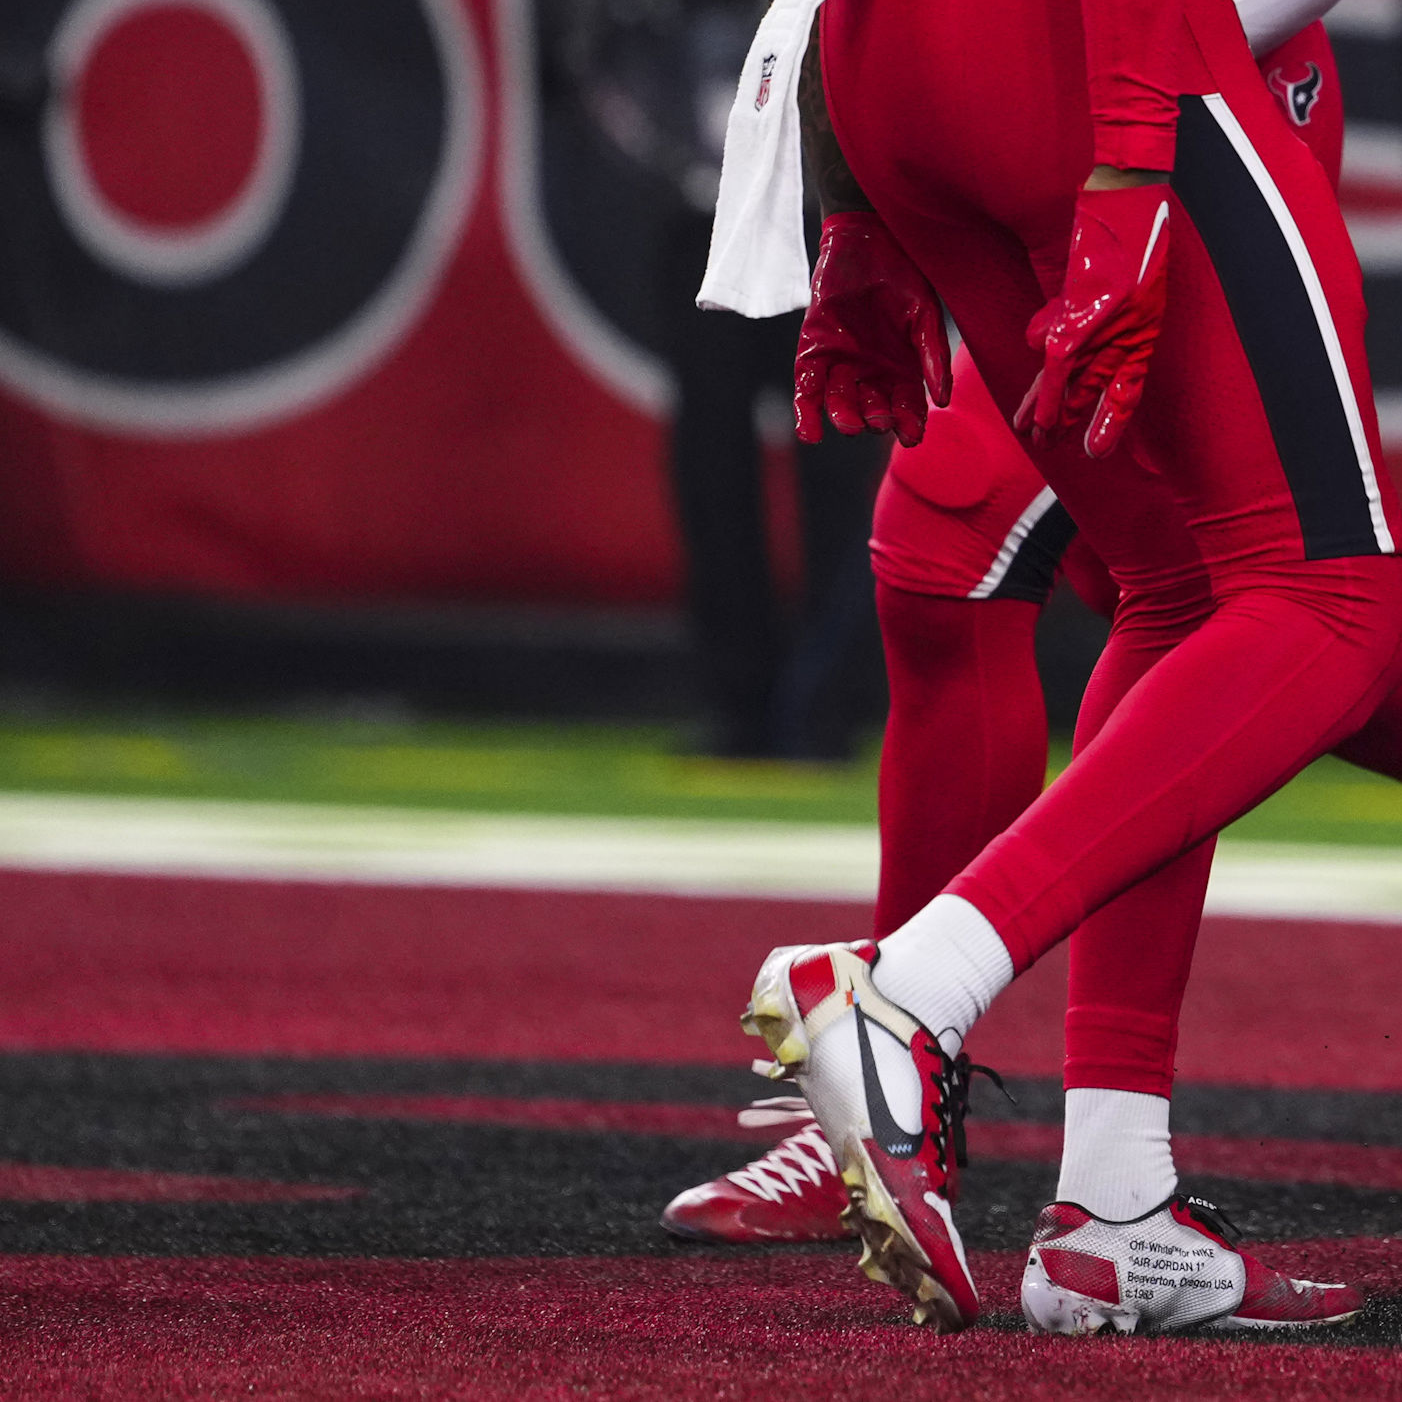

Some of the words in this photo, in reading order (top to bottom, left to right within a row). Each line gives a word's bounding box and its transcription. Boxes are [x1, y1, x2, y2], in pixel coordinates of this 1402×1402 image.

[1192, 1248, 1215, 1258] NIKE
[1152, 1259, 1193, 1272] JORDAN
[1127, 1271, 1177, 1289] Beaverton,
[1214, 1279, 1234, 1290] USA
